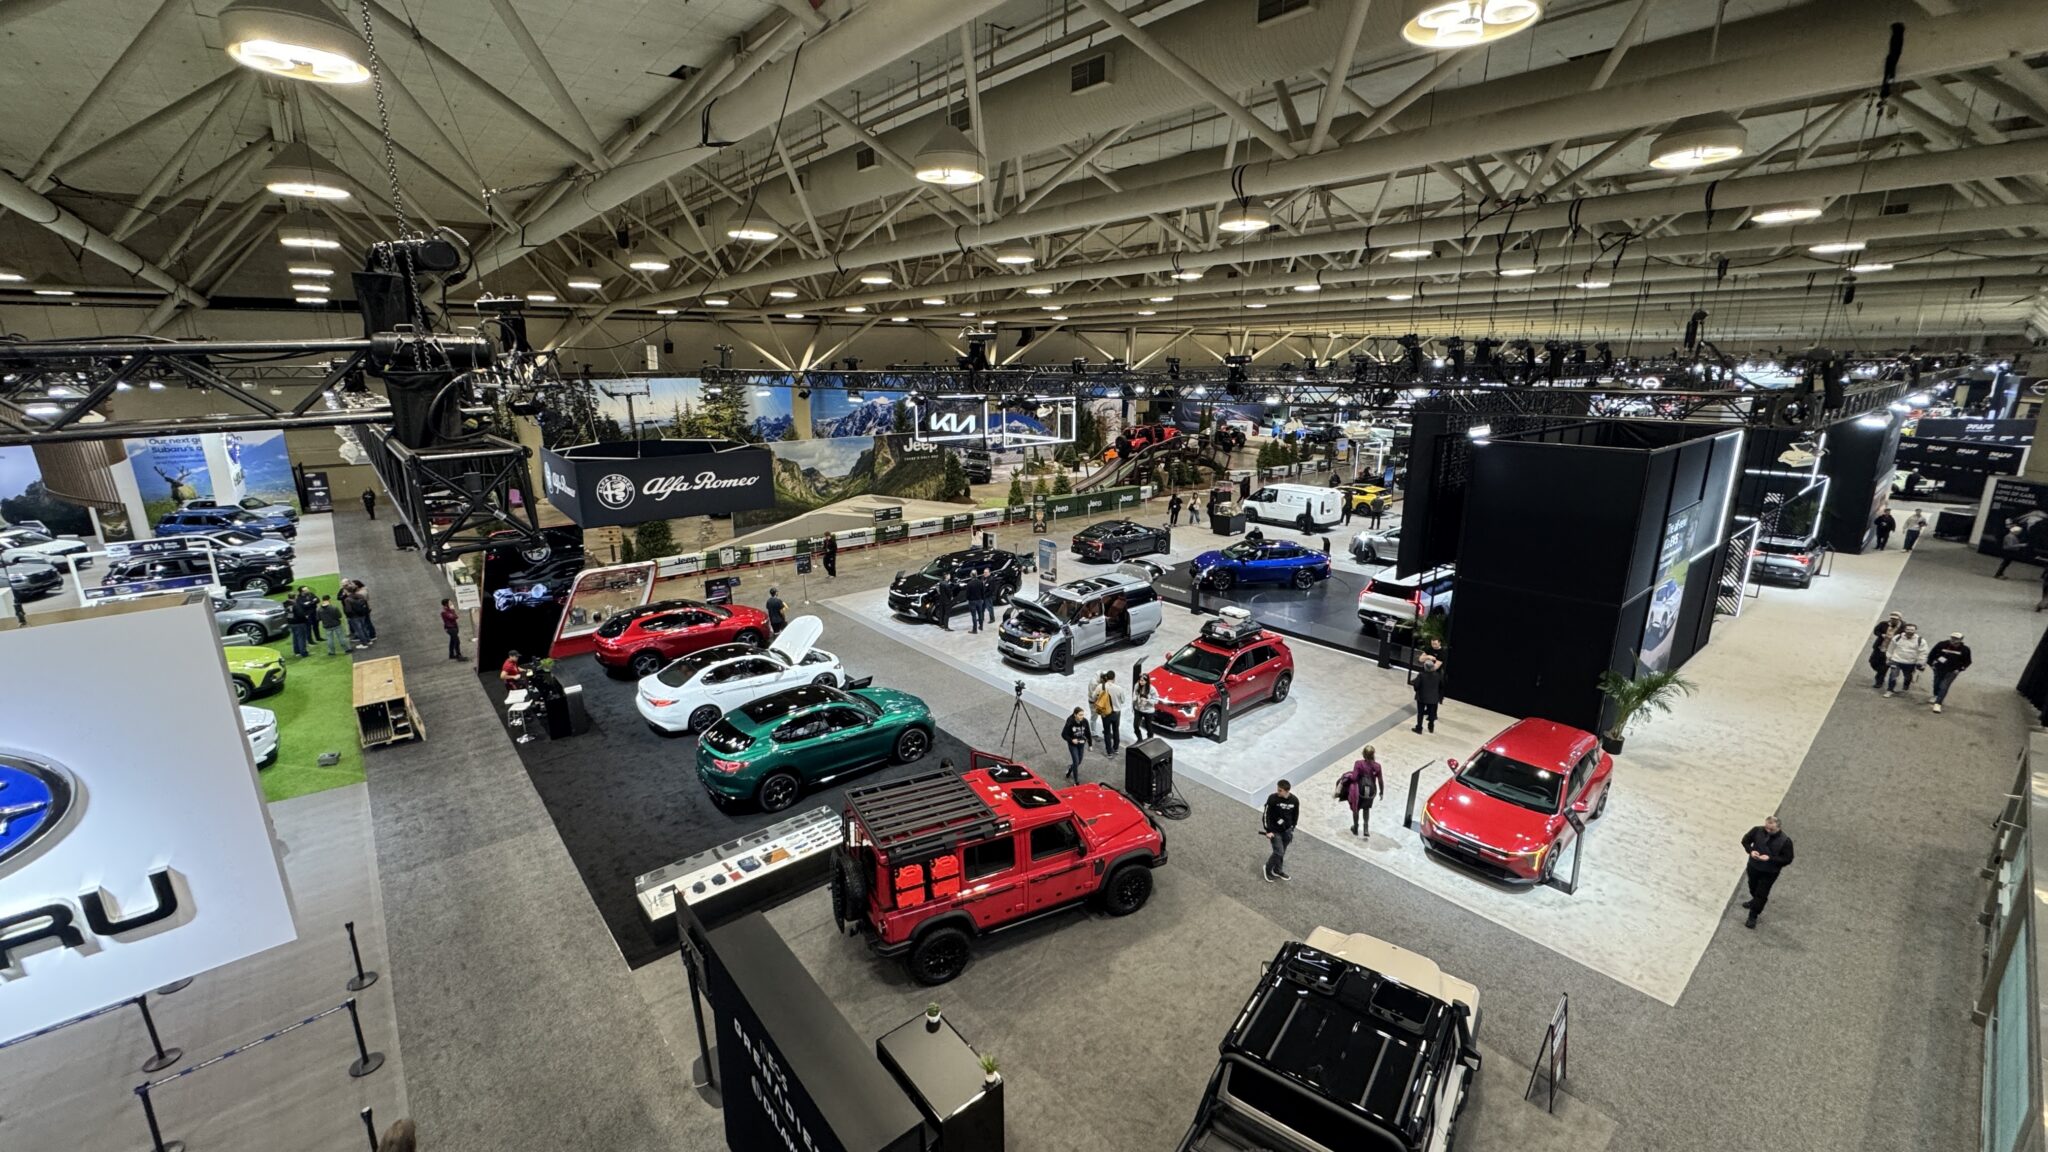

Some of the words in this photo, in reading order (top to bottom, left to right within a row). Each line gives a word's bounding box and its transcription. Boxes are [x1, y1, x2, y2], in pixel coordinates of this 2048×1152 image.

[903, 437, 938, 453] Jeep
[642, 475, 694, 501] Alfa
[692, 471, 760, 491] Romeo
[952, 514, 968, 522] Jeep
[885, 525, 902, 533] Jeep
[766, 543, 786, 552] Jeep
[674, 556, 697, 566] Jeep
